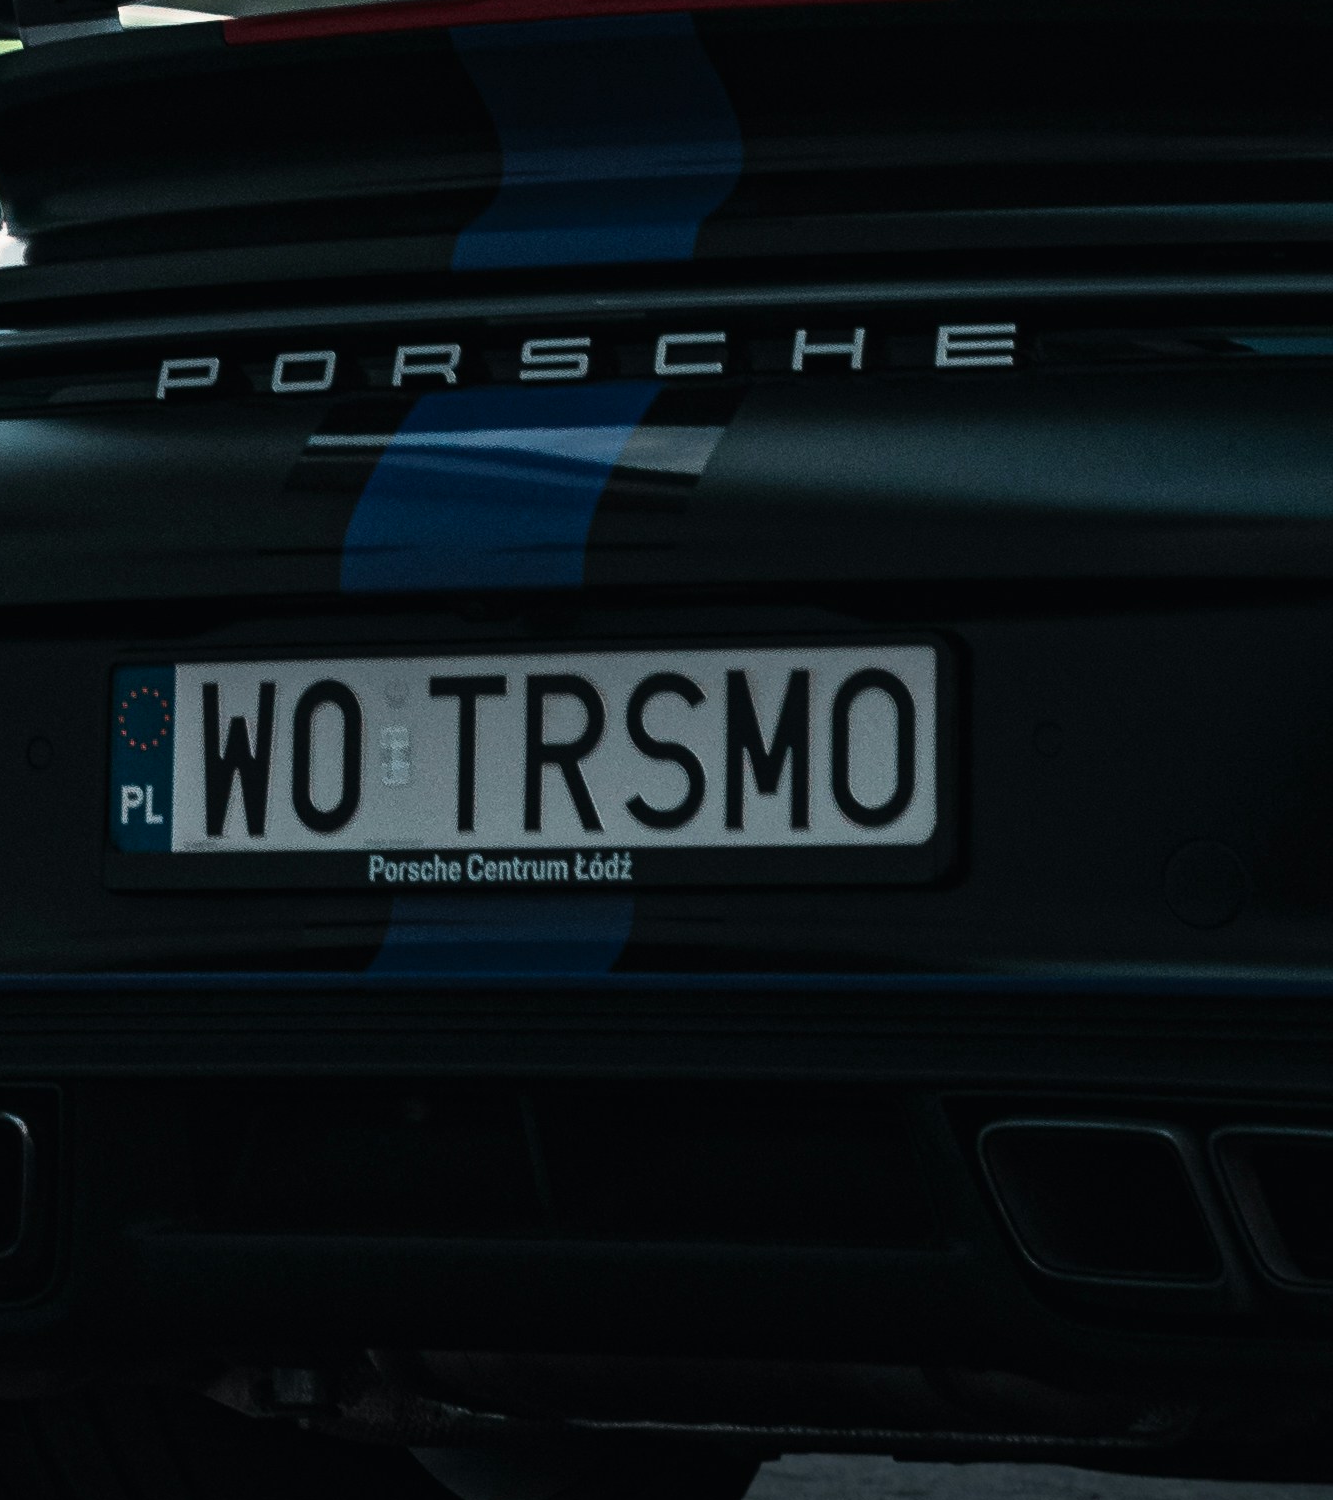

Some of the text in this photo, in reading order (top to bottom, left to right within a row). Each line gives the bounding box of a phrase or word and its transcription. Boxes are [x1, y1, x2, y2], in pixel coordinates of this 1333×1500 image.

[155, 322, 1017, 400] PORSCHE
[429, 667, 918, 834] TRSMO
[120, 784, 164, 826] PL
[368, 851, 634, 883] Porsche Centrum Łódź
